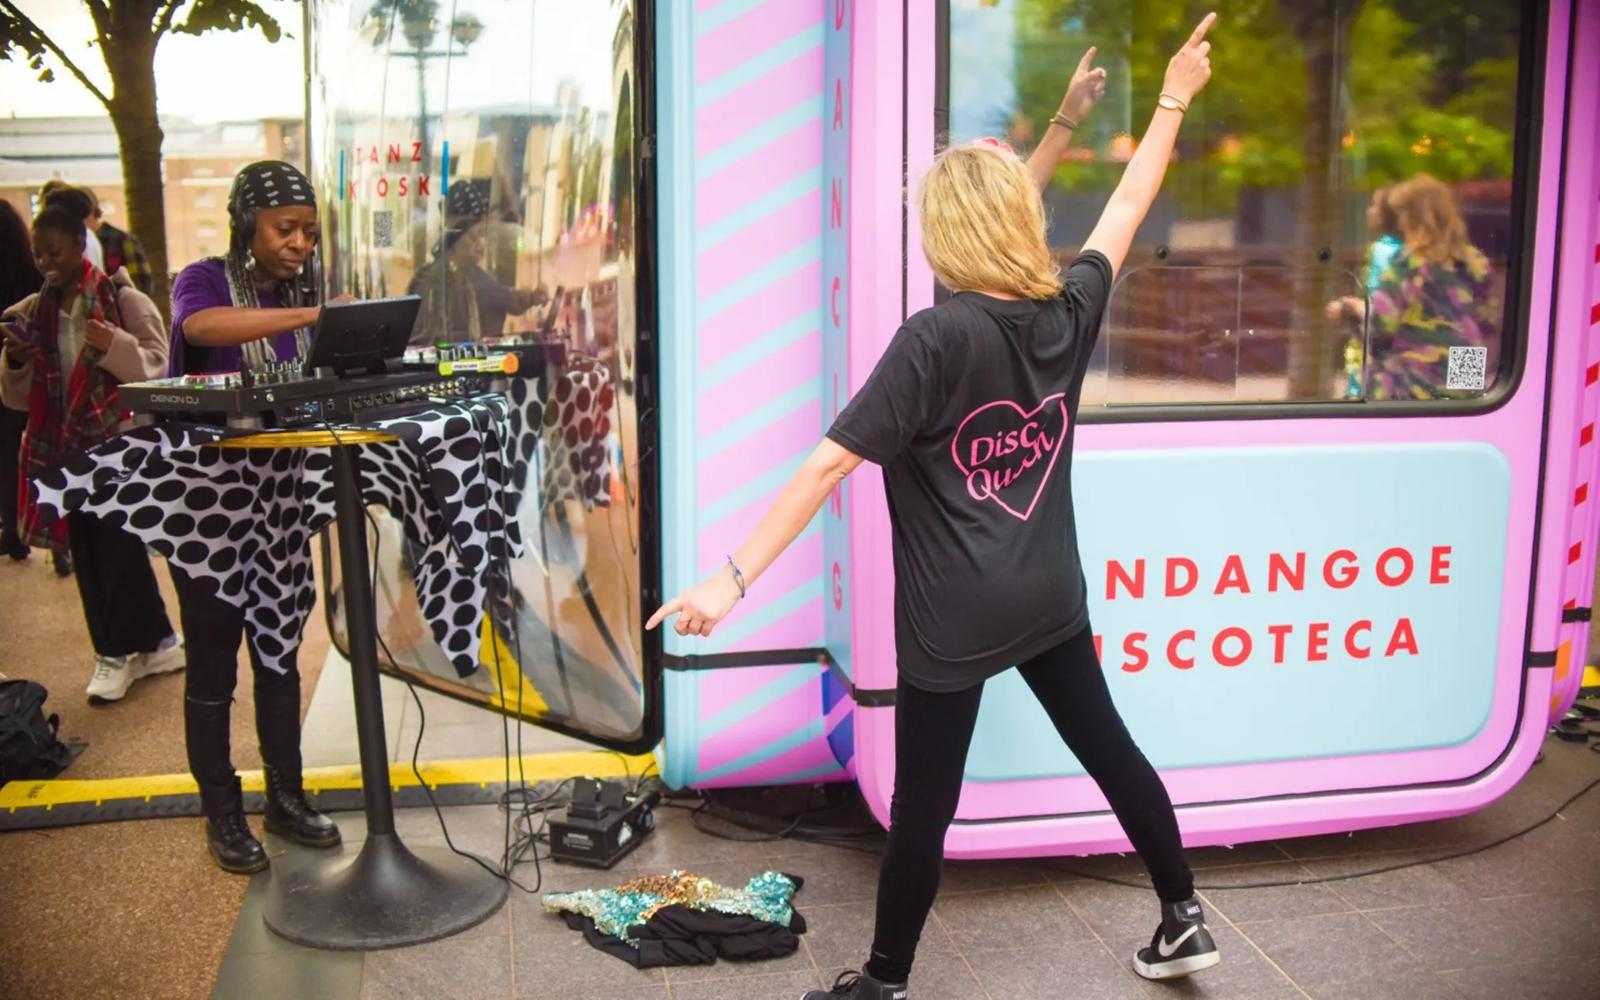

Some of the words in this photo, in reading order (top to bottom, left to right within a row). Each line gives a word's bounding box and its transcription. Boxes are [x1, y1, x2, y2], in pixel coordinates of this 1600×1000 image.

[355, 141, 423, 165] TANZ
[349, 175, 430, 198] KIOSK
[150, 394, 185, 405] DENON
[186, 395, 200, 405] DJ
[1105, 545, 1452, 601] NDANGOE
